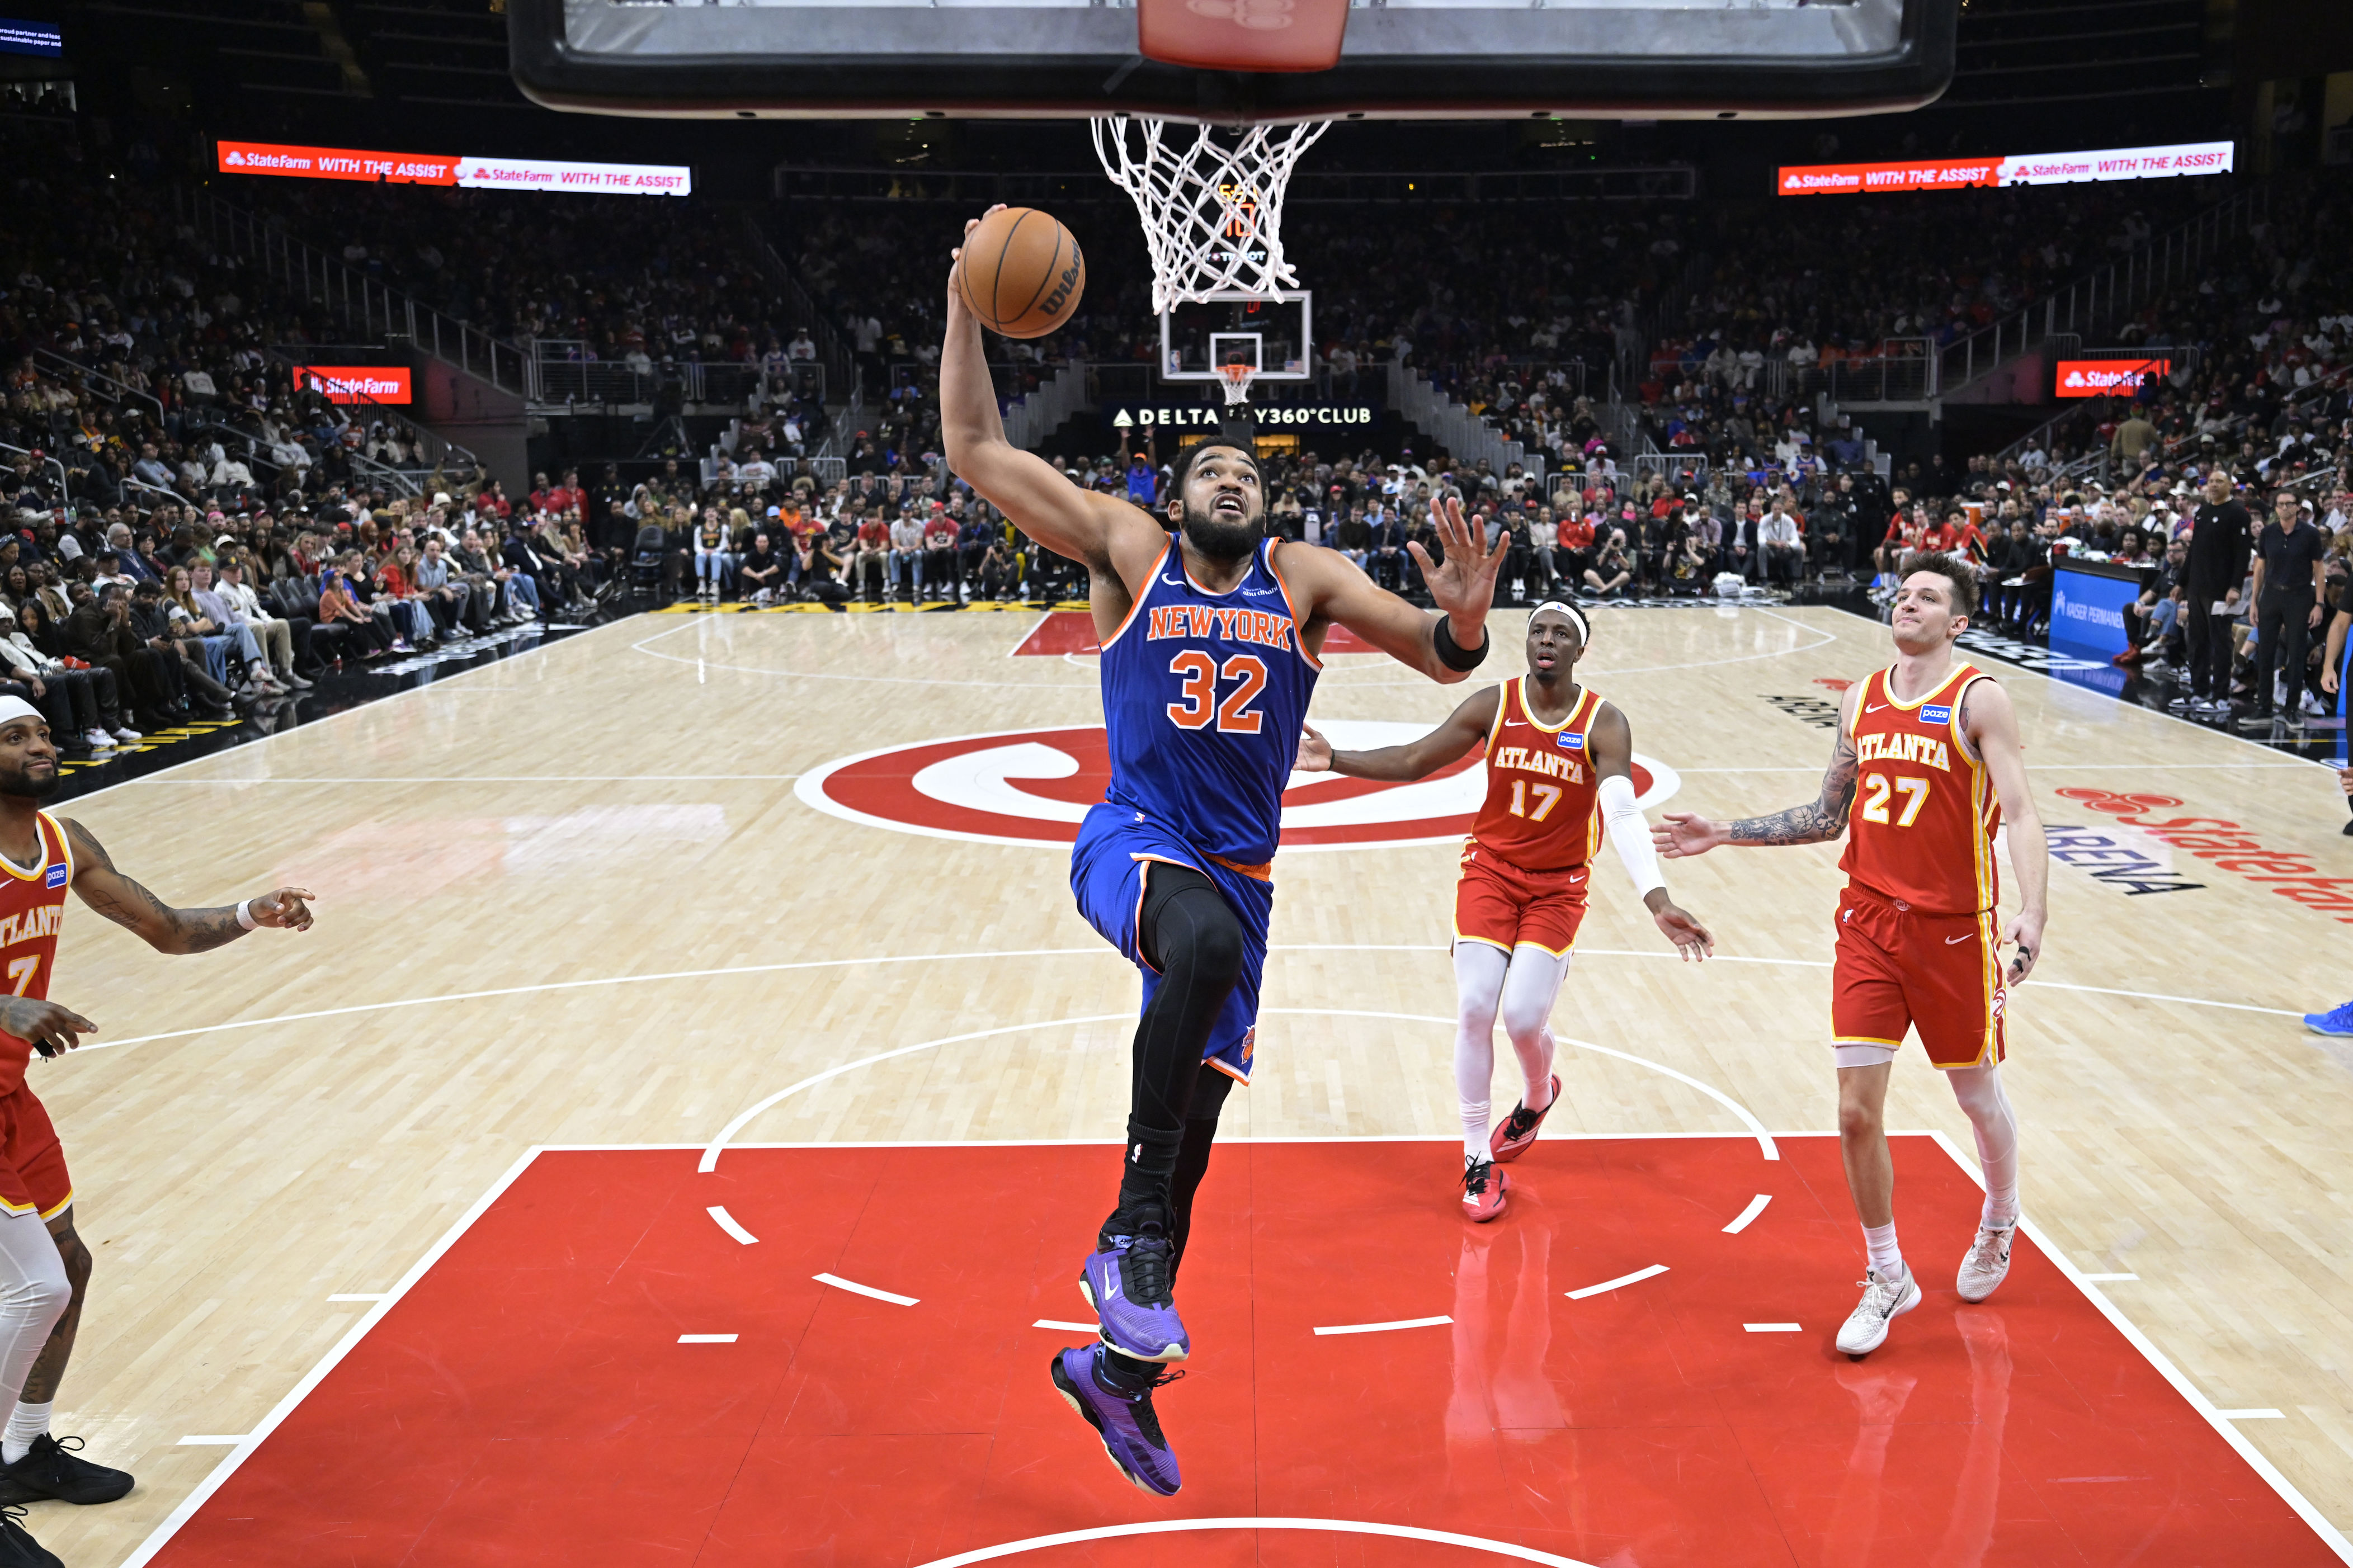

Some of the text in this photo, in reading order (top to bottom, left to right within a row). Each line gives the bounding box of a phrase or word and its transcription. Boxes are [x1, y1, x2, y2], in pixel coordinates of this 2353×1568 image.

[319, 157, 360, 173] WITH
[364, 160, 392, 175] THE
[395, 162, 447, 178] ASSIST
[2098, 159, 2137, 173] WITH
[2142, 157, 2170, 170] THE
[2173, 153, 2227, 168] ASSIST
[562, 172, 600, 185] WITH
[605, 174, 631, 186] THE
[635, 176, 683, 188] ASSIST
[1866, 171, 1904, 185] WITH
[1908, 169, 1937, 183] THE
[1938, 167, 1990, 182] ASSIST
[1227, 204, 1255, 237] 10
[1220, 251, 1266, 262] TIOT
[2086, 370, 2145, 387] StateFar
[1139, 408, 1219, 425] DELTA
[1257, 584, 1278, 596] dhabi
[2067, 602, 2087, 621] KAISER
[1147, 604, 1294, 653] NEW YORK
[1166, 649, 1268, 735] 32
[1922, 709, 1949, 719] paze
[1560, 734, 1582, 744] paze
[1857, 733, 1951, 772] ATLANTA
[1494, 747, 1584, 785] ATLANTA
[1509, 779, 1563, 822] 17
[1862, 773, 1930, 827] 27
[48, 869, 65, 883] paze
[2116, 816, 2353, 924] StateFa
[0, 905, 63, 949] TLANT
[8, 955, 41, 997] 7
